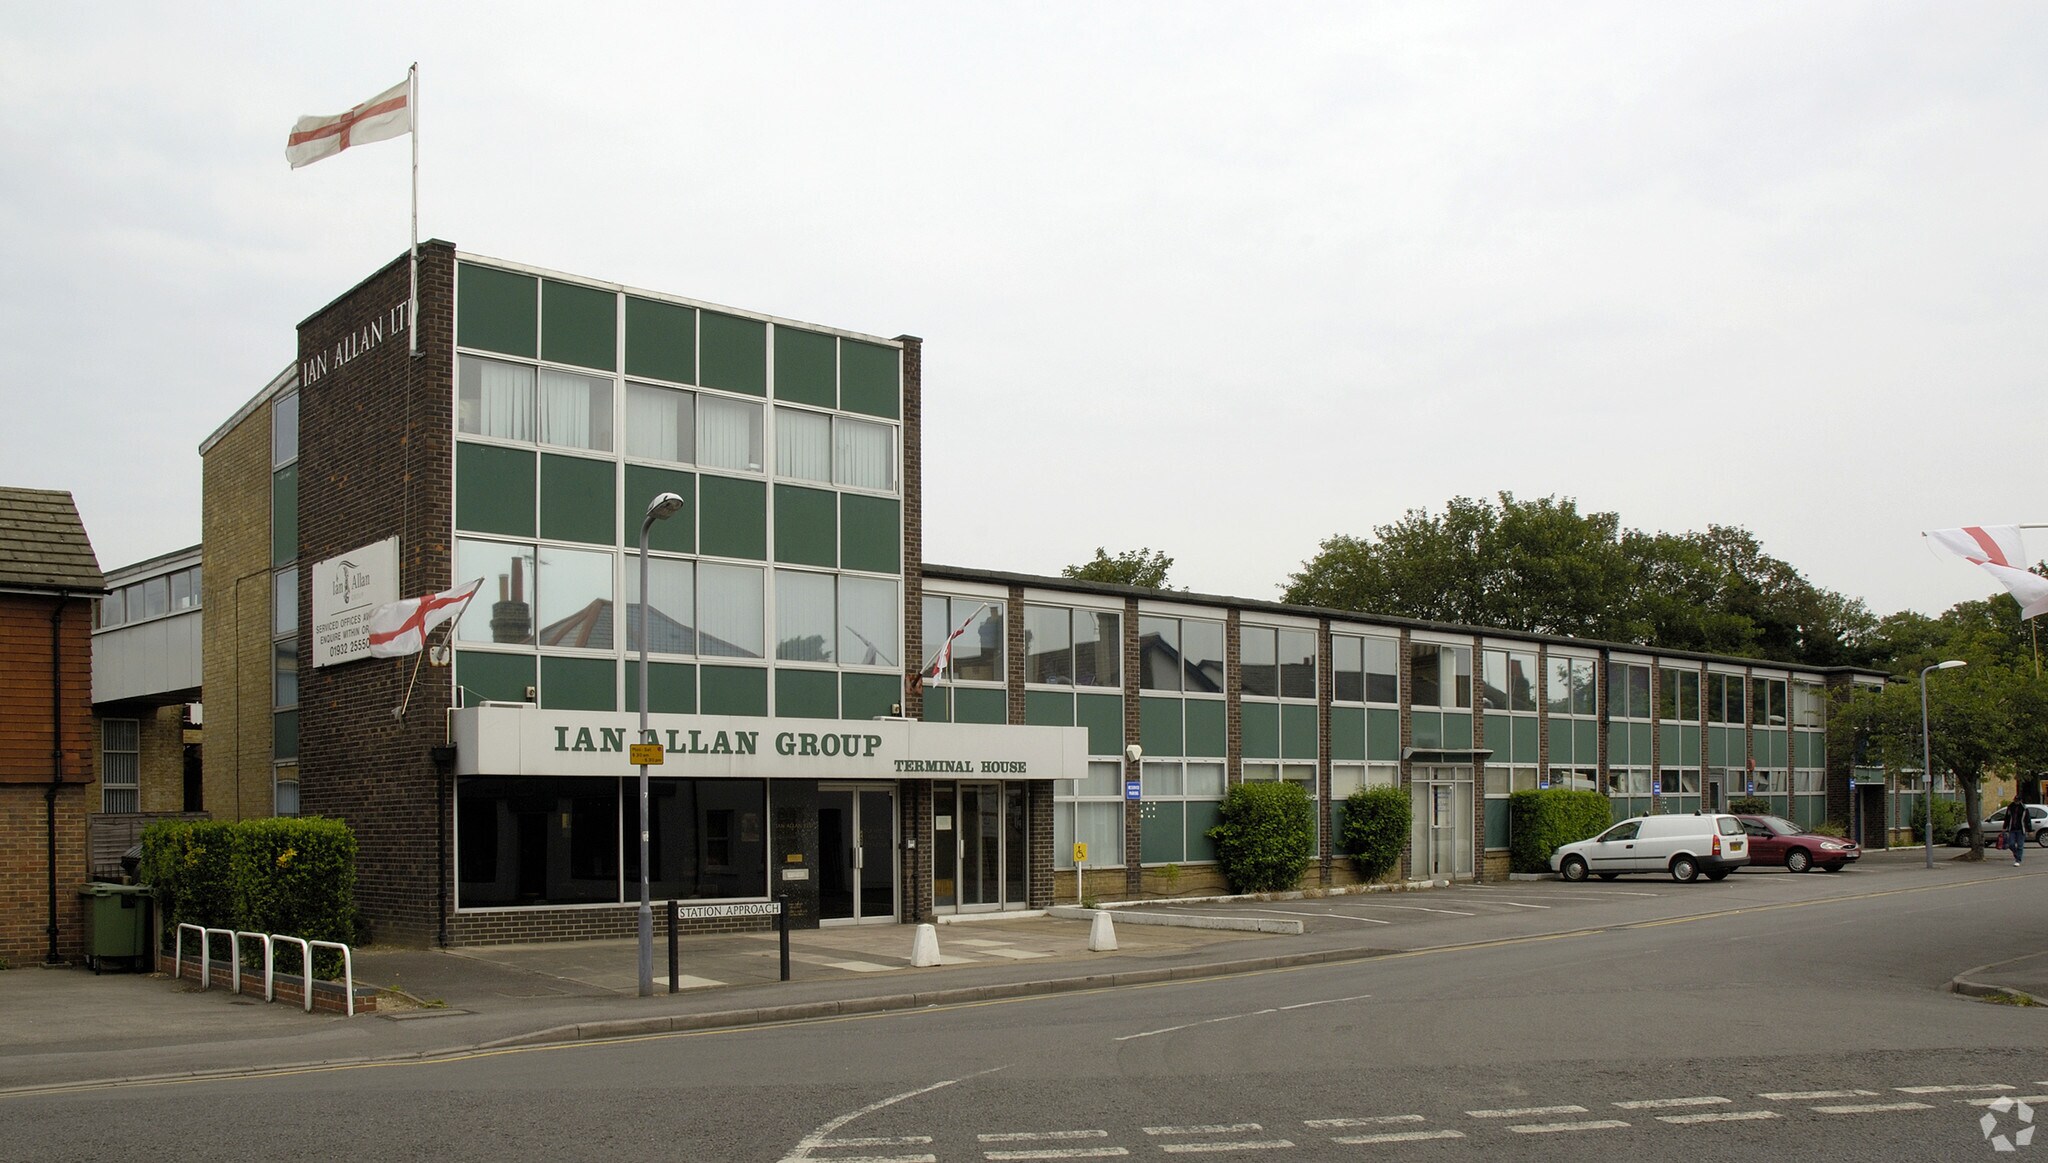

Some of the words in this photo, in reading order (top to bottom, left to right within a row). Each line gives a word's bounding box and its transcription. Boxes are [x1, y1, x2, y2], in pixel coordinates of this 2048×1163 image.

[303, 350, 327, 387] IAN
[334, 316, 383, 369] ALLAN
[390, 299, 411, 336] LT
[333, 581, 343, 595] Ian
[352, 573, 370, 589] Allan
[316, 620, 339, 634] SERVICED
[340, 614, 361, 628] OFFICES
[320, 632, 341, 644] ENQUIRE
[343, 627, 360, 638] WITHIN
[330, 643, 348, 657] 01932
[554, 726, 626, 752] IAN
[775, 732, 883, 757] GROUP
[894, 760, 974, 773] TERMINAL
[980, 761, 1027, 773] HOUSE
[680, 906, 722, 918] STATION
[726, 904, 779, 916] APPROACH
